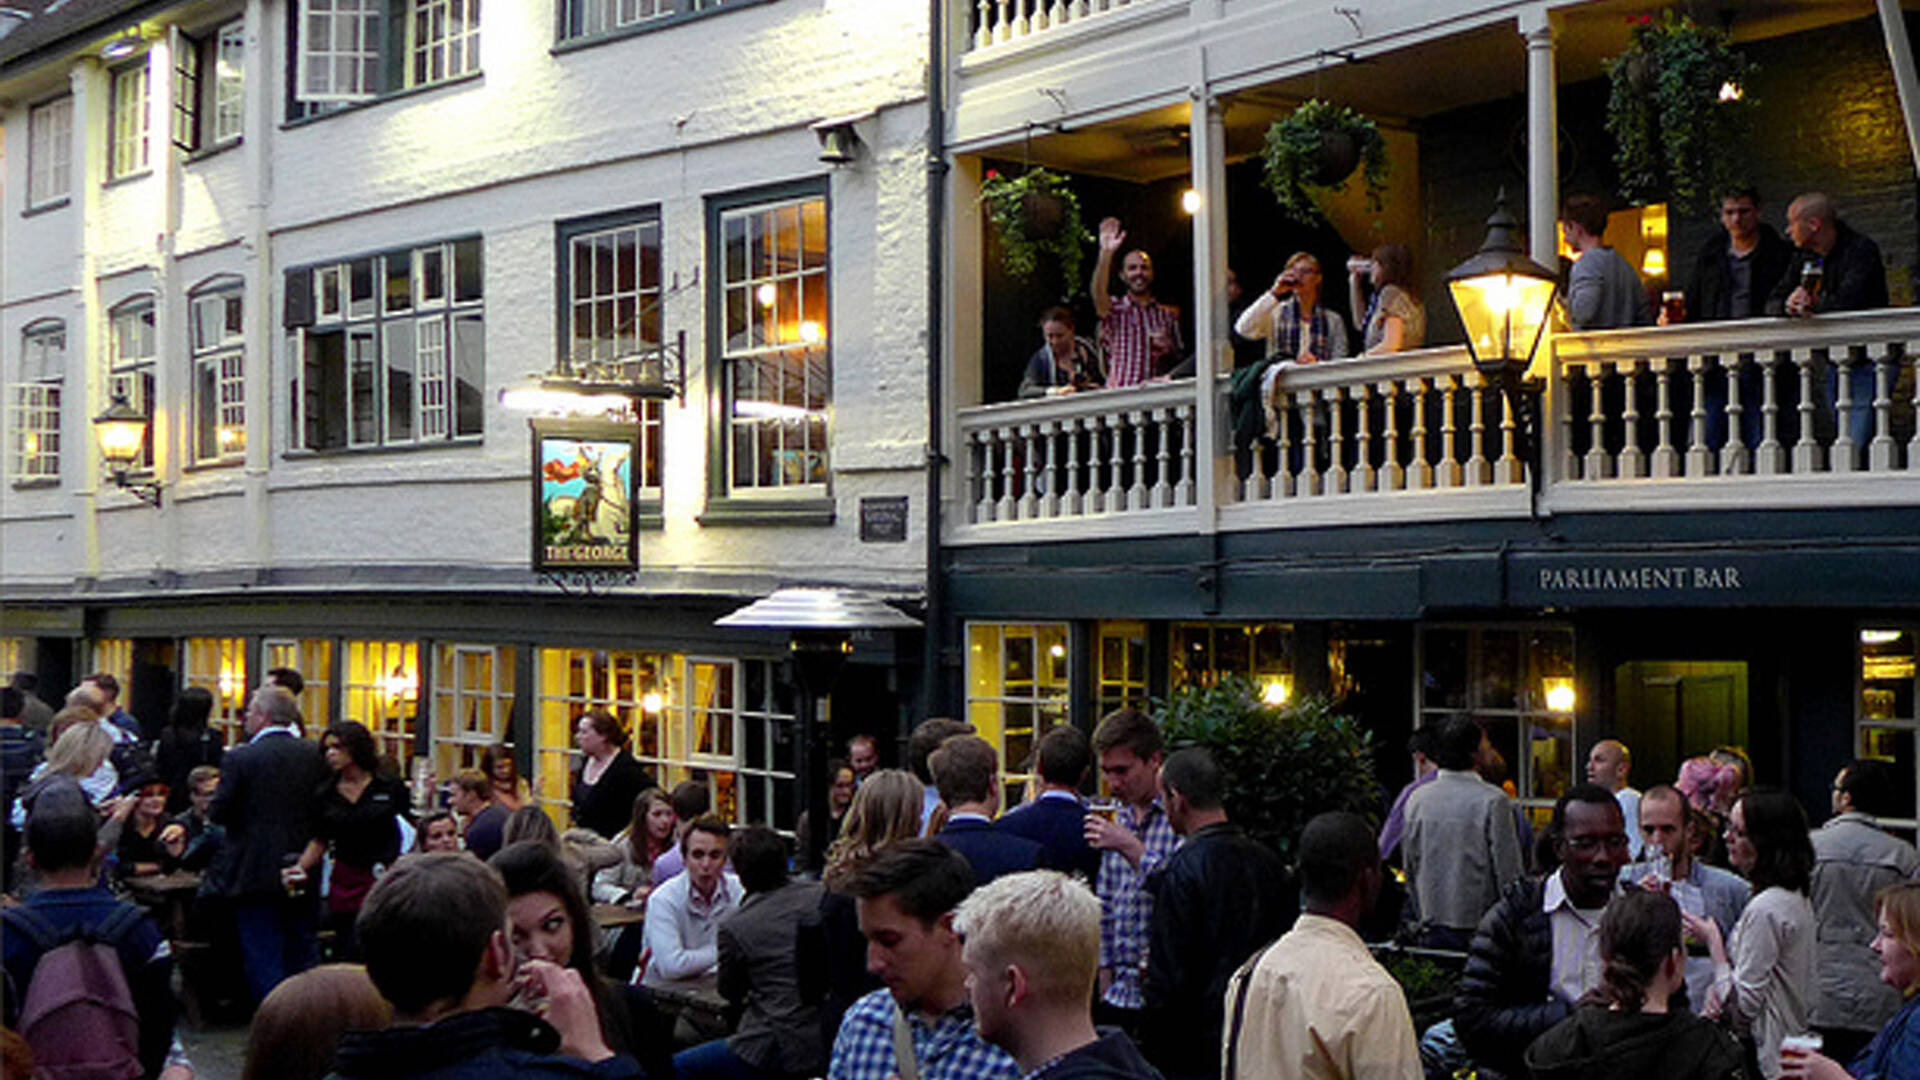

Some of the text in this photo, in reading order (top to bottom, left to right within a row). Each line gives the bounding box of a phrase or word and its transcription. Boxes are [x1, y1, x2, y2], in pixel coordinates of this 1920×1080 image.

[545, 545, 628, 560] THE GEORGE
[1539, 567, 1742, 588] PARLIAMENT BAR
